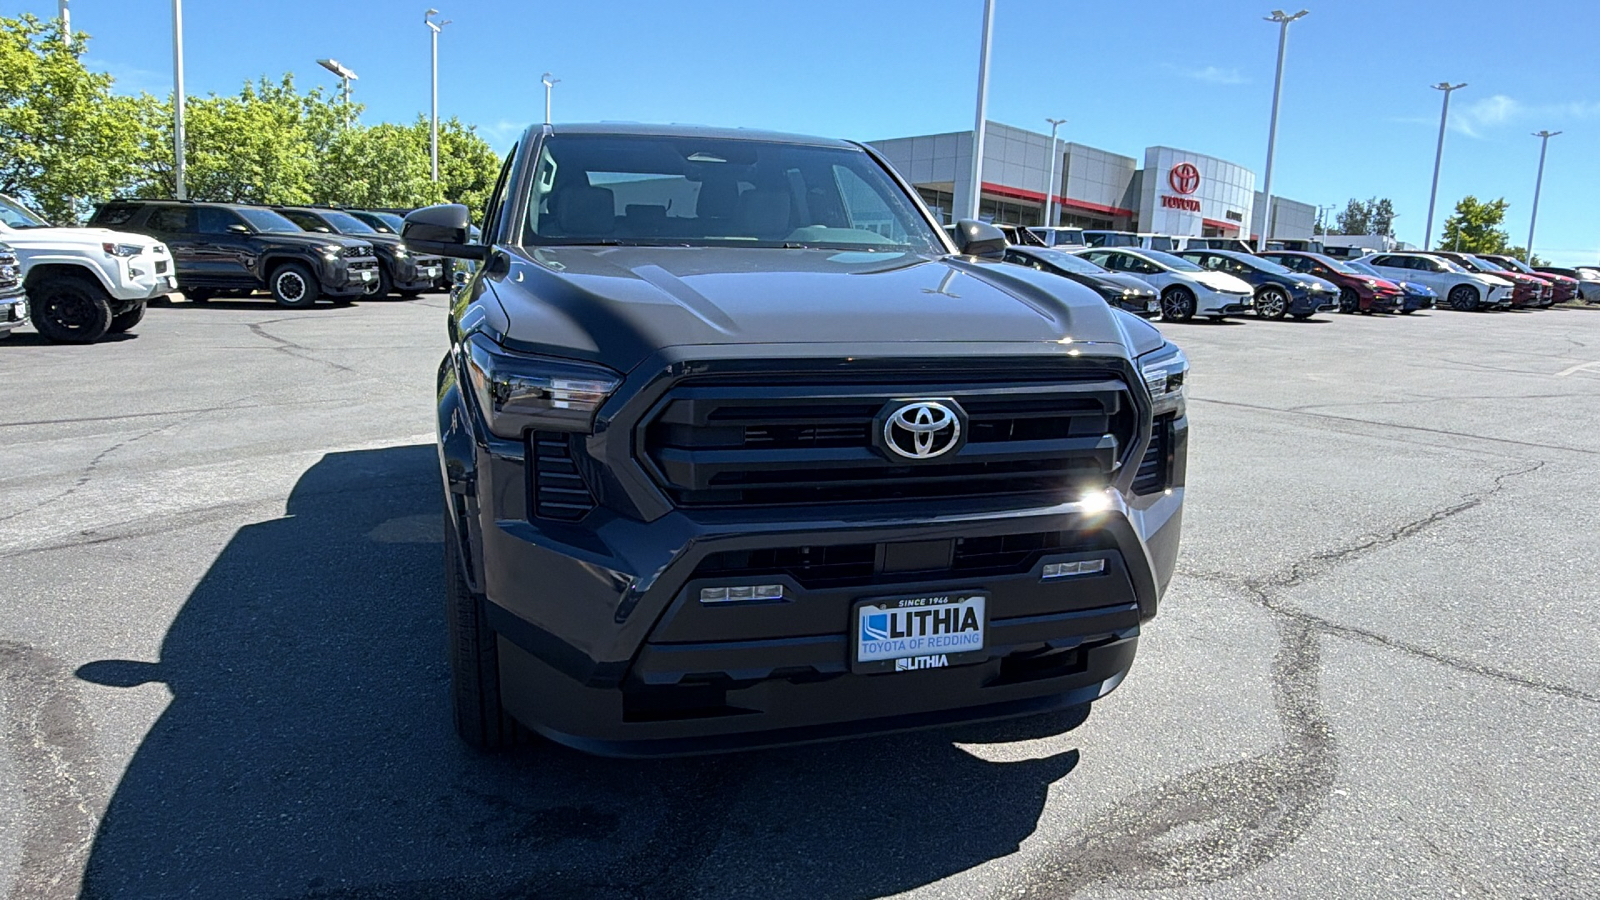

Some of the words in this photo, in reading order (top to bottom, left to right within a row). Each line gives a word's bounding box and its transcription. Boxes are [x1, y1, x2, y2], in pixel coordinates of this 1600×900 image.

[1161, 195, 1201, 212] TOYOTA
[898, 598, 926, 607] SINCE
[929, 597, 948, 605] 1946
[890, 606, 979, 639] LITHIA
[862, 640, 906, 654] TOYOTA
[909, 639, 925, 650] OF
[927, 633, 979, 648] REDDING
[907, 654, 949, 671] LITHIA
